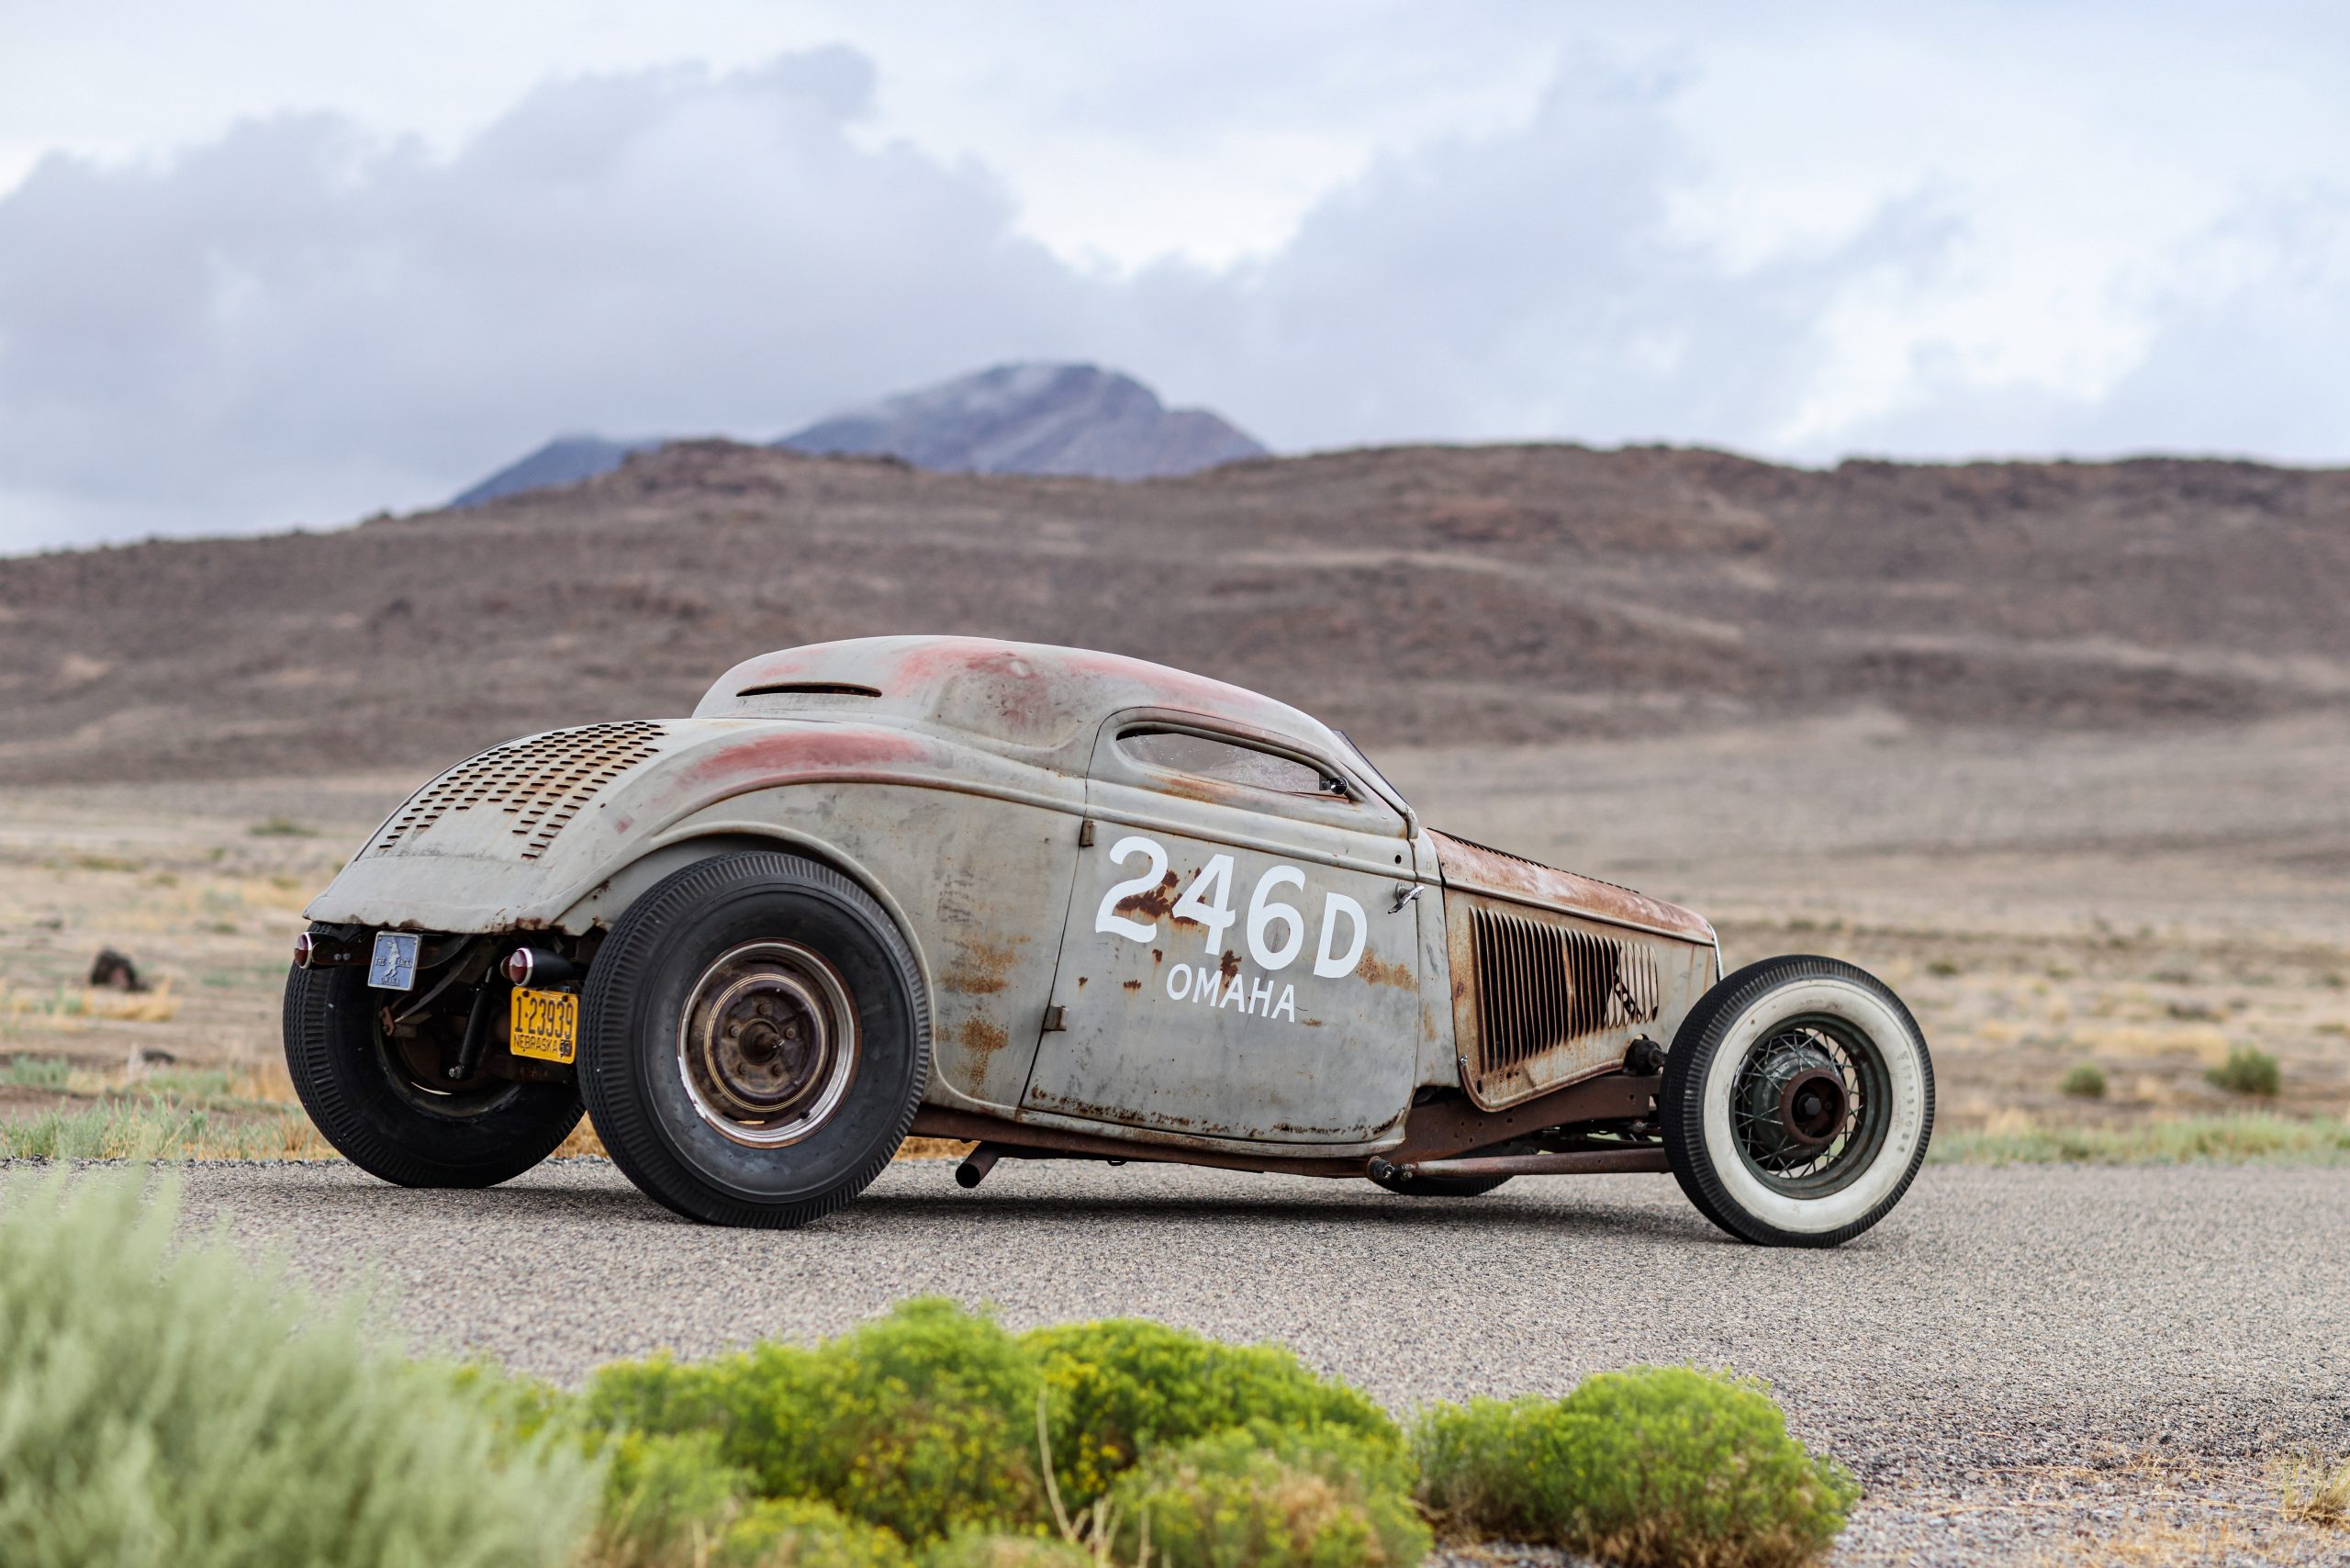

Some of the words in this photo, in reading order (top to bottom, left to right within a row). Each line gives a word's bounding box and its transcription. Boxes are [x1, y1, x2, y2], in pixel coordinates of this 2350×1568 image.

[1096, 836, 1367, 978] 246D
[1167, 964, 1295, 1023] OMAHA
[514, 1034, 558, 1053] NEBRASKA
